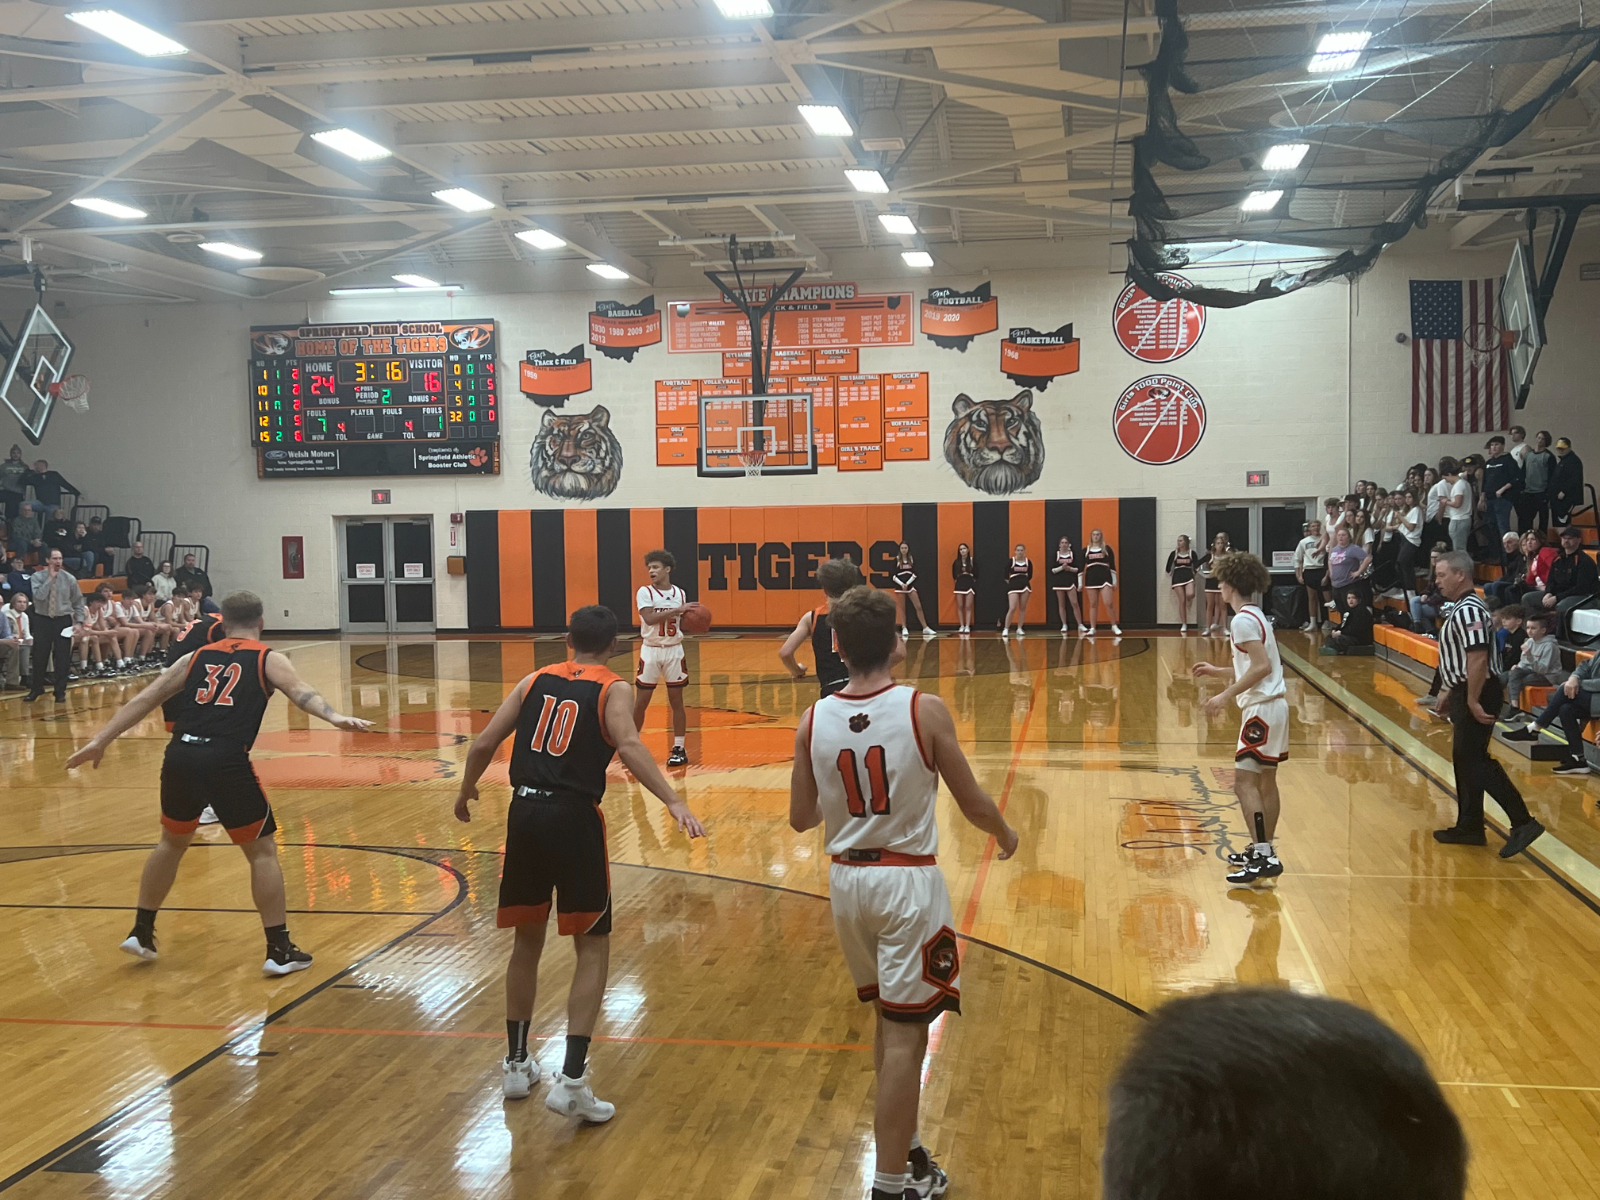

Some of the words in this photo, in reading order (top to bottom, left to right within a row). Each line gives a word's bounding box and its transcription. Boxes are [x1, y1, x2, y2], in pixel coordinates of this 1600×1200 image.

[938, 297, 983, 305] FOOTBALL
[1119, 287, 1136, 309] Boys
[608, 309, 643, 317] BASEBALL
[924, 310, 941, 320] 2019
[943, 313, 960, 322] 2020
[299, 325, 369, 338] SPRINGFIELD
[372, 325, 399, 336] HIGH
[401, 323, 443, 335] SCHOOL
[591, 323, 606, 334] 1930
[609, 327, 624, 336] 1980
[627, 327, 643, 336] 2009
[645, 321, 660, 333] 2011
[591, 332, 606, 344] 2013
[1016, 336, 1065, 344] BASKETBALL
[296, 340, 336, 356] HOME
[340, 339, 358, 354] OF
[361, 338, 391, 354] THE
[395, 336, 447, 353] TIGERS
[305, 362, 333, 373] HOME
[409, 358, 443, 369] VISITOR
[453, 363, 461, 375] 0
[467, 363, 474, 374] 0
[486, 362, 494, 374] 4
[263, 369, 268, 380] 1
[276, 369, 280, 379] 1
[291, 368, 299, 380] 2
[354, 361, 402, 382] 3:16
[310, 375, 335, 395] 24
[423, 371, 442, 392] 16
[454, 380, 462, 390] 4
[471, 380, 475, 390] 1
[486, 378, 494, 390] 5
[257, 384, 268, 396] 10
[277, 385, 281, 395] 1
[292, 383, 300, 395] 2
[355, 391, 379, 400] PERIOD
[1119, 391, 1135, 411] Girls
[1160, 377, 1185, 392] Point
[1184, 389, 1198, 410] Club
[318, 397, 340, 405] BONUS
[382, 388, 391, 404] 2
[408, 395, 430, 403] BONUS
[455, 395, 462, 406] 5
[487, 394, 495, 406] 3
[258, 400, 269, 411] 11
[292, 399, 301, 411] 2
[306, 409, 327, 417] FOULS
[350, 408, 375, 416] PLAYER
[449, 410, 463, 422] 32
[469, 410, 476, 421] 0
[488, 409, 495, 421] 0
[259, 415, 269, 427] 12
[278, 415, 282, 426] 1
[293, 414, 302, 426] 5
[317, 417, 327, 432] 7
[404, 420, 414, 431] 4
[438, 415, 443, 430] 1
[337, 422, 346, 433] 4
[260, 430, 270, 442] 15
[275, 430, 283, 442] 2
[335, 433, 348, 441] TOL
[287, 450, 309, 458] Welsh
[310, 450, 335, 458] Motors
[698, 540, 902, 591] TIGERS
[658, 618, 677, 637] 15
[195, 662, 242, 706] 32
[531, 694, 579, 757] 10
[836, 744, 891, 819] 11
